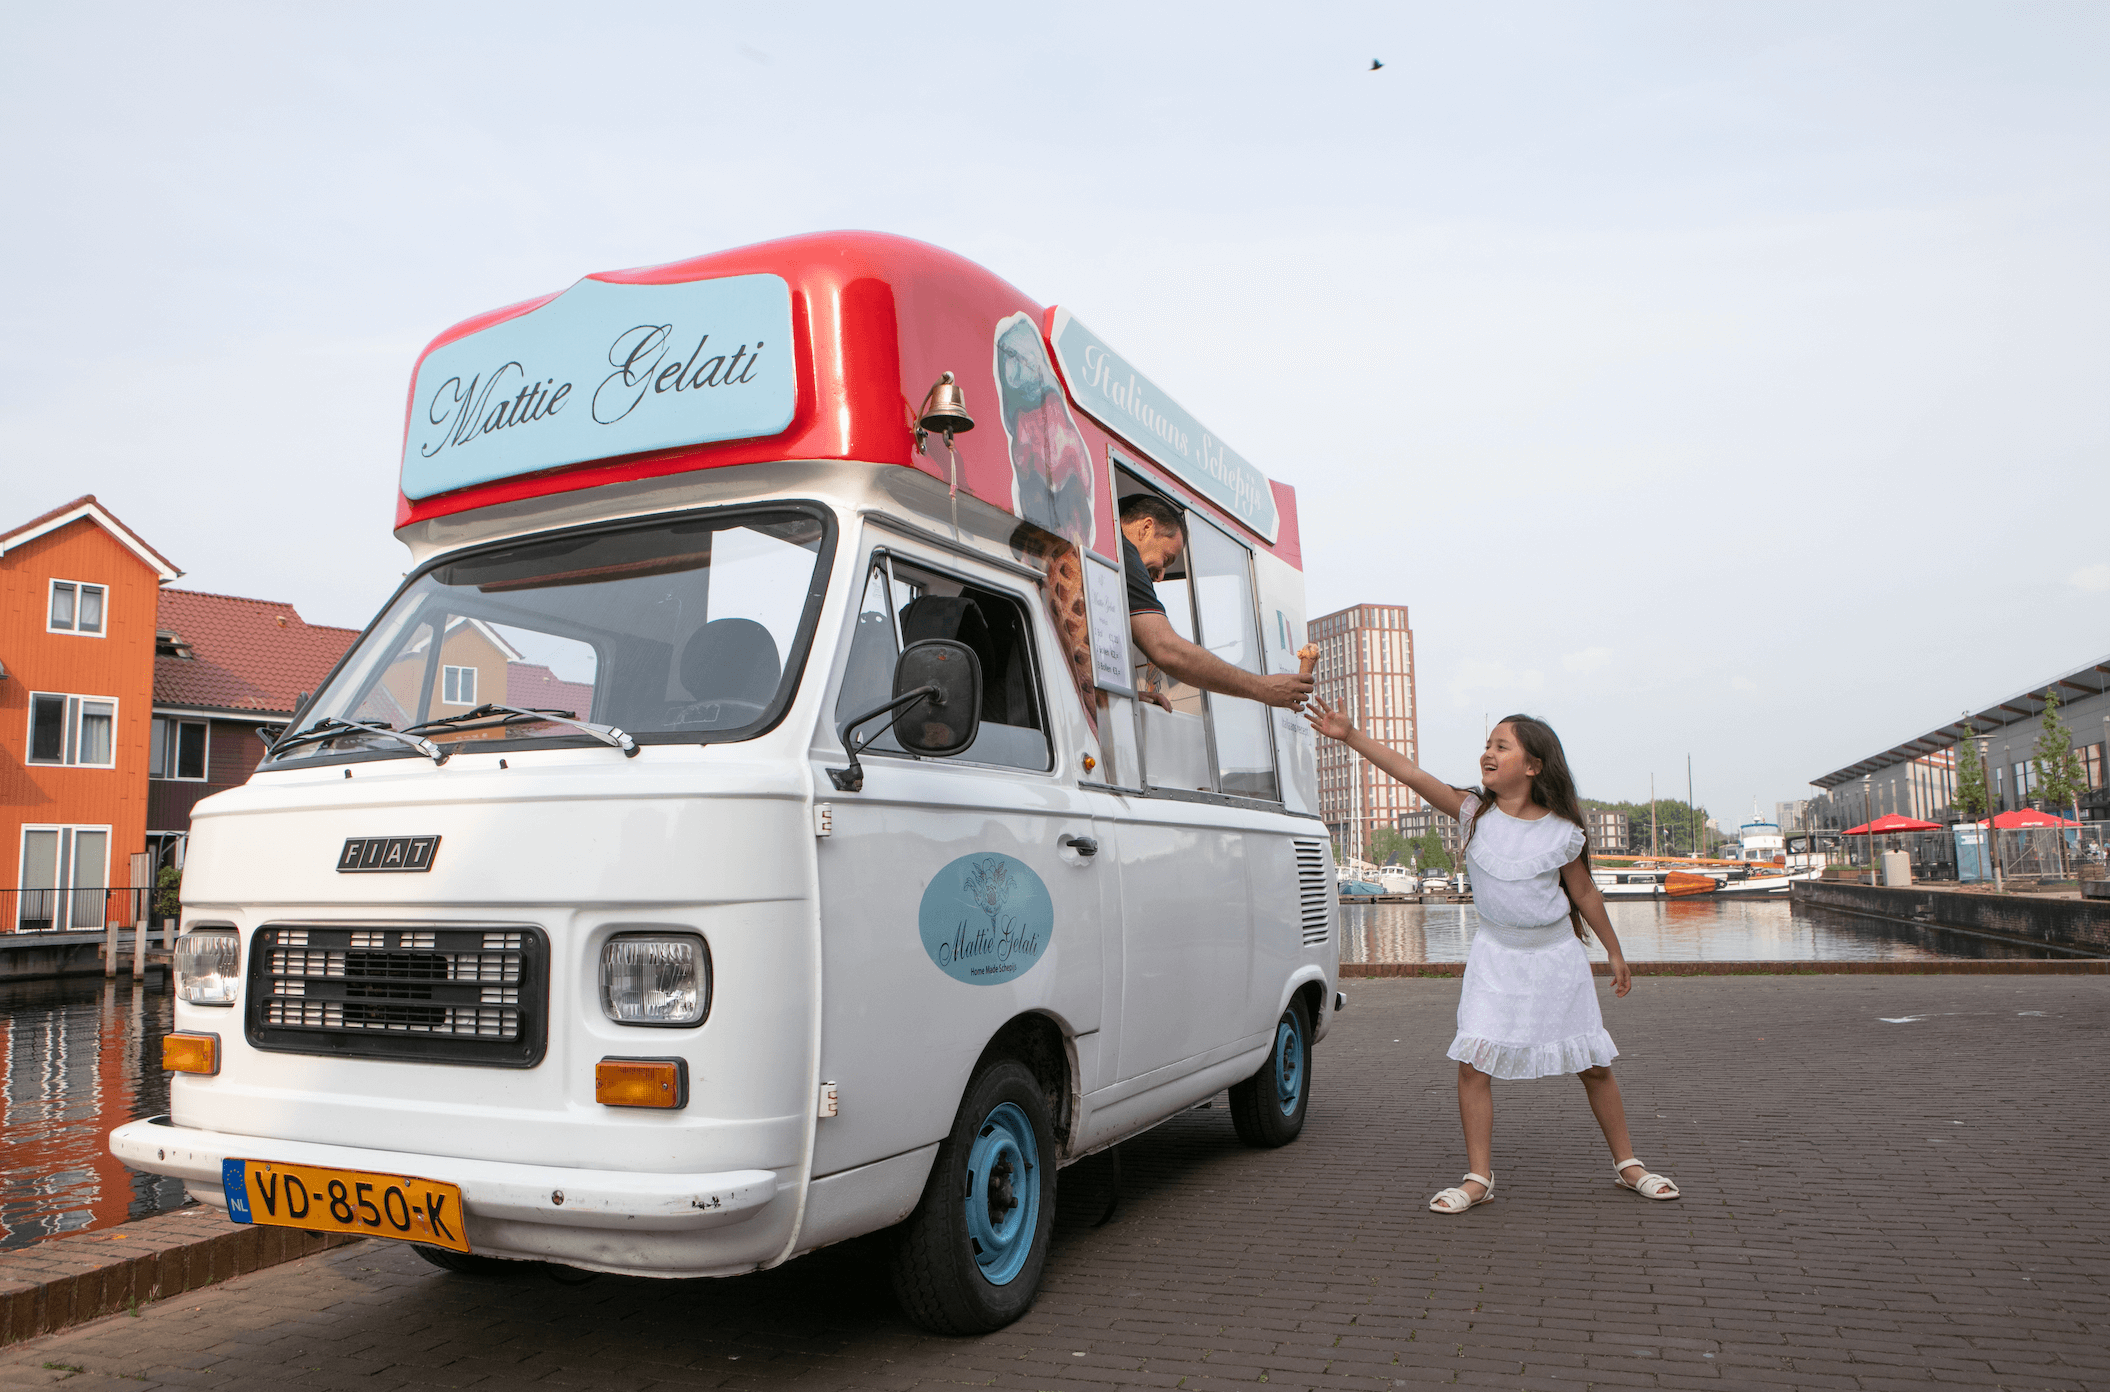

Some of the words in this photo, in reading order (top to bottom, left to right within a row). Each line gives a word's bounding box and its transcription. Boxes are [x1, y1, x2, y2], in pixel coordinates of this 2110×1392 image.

[421, 361, 572, 458] Mattie
[592, 323, 764, 425] Gelati
[1082, 345, 1190, 457] Italiaans
[1196, 433, 1261, 517] Schepijs
[345, 842, 428, 864] FIAT
[939, 919, 994, 967] Mattie
[997, 914, 1040, 962] Gelati
[970, 967, 985, 977] Home
[985, 963, 999, 974] Made
[231, 1198, 248, 1212] NL
[255, 1171, 457, 1242] VD-850-K
